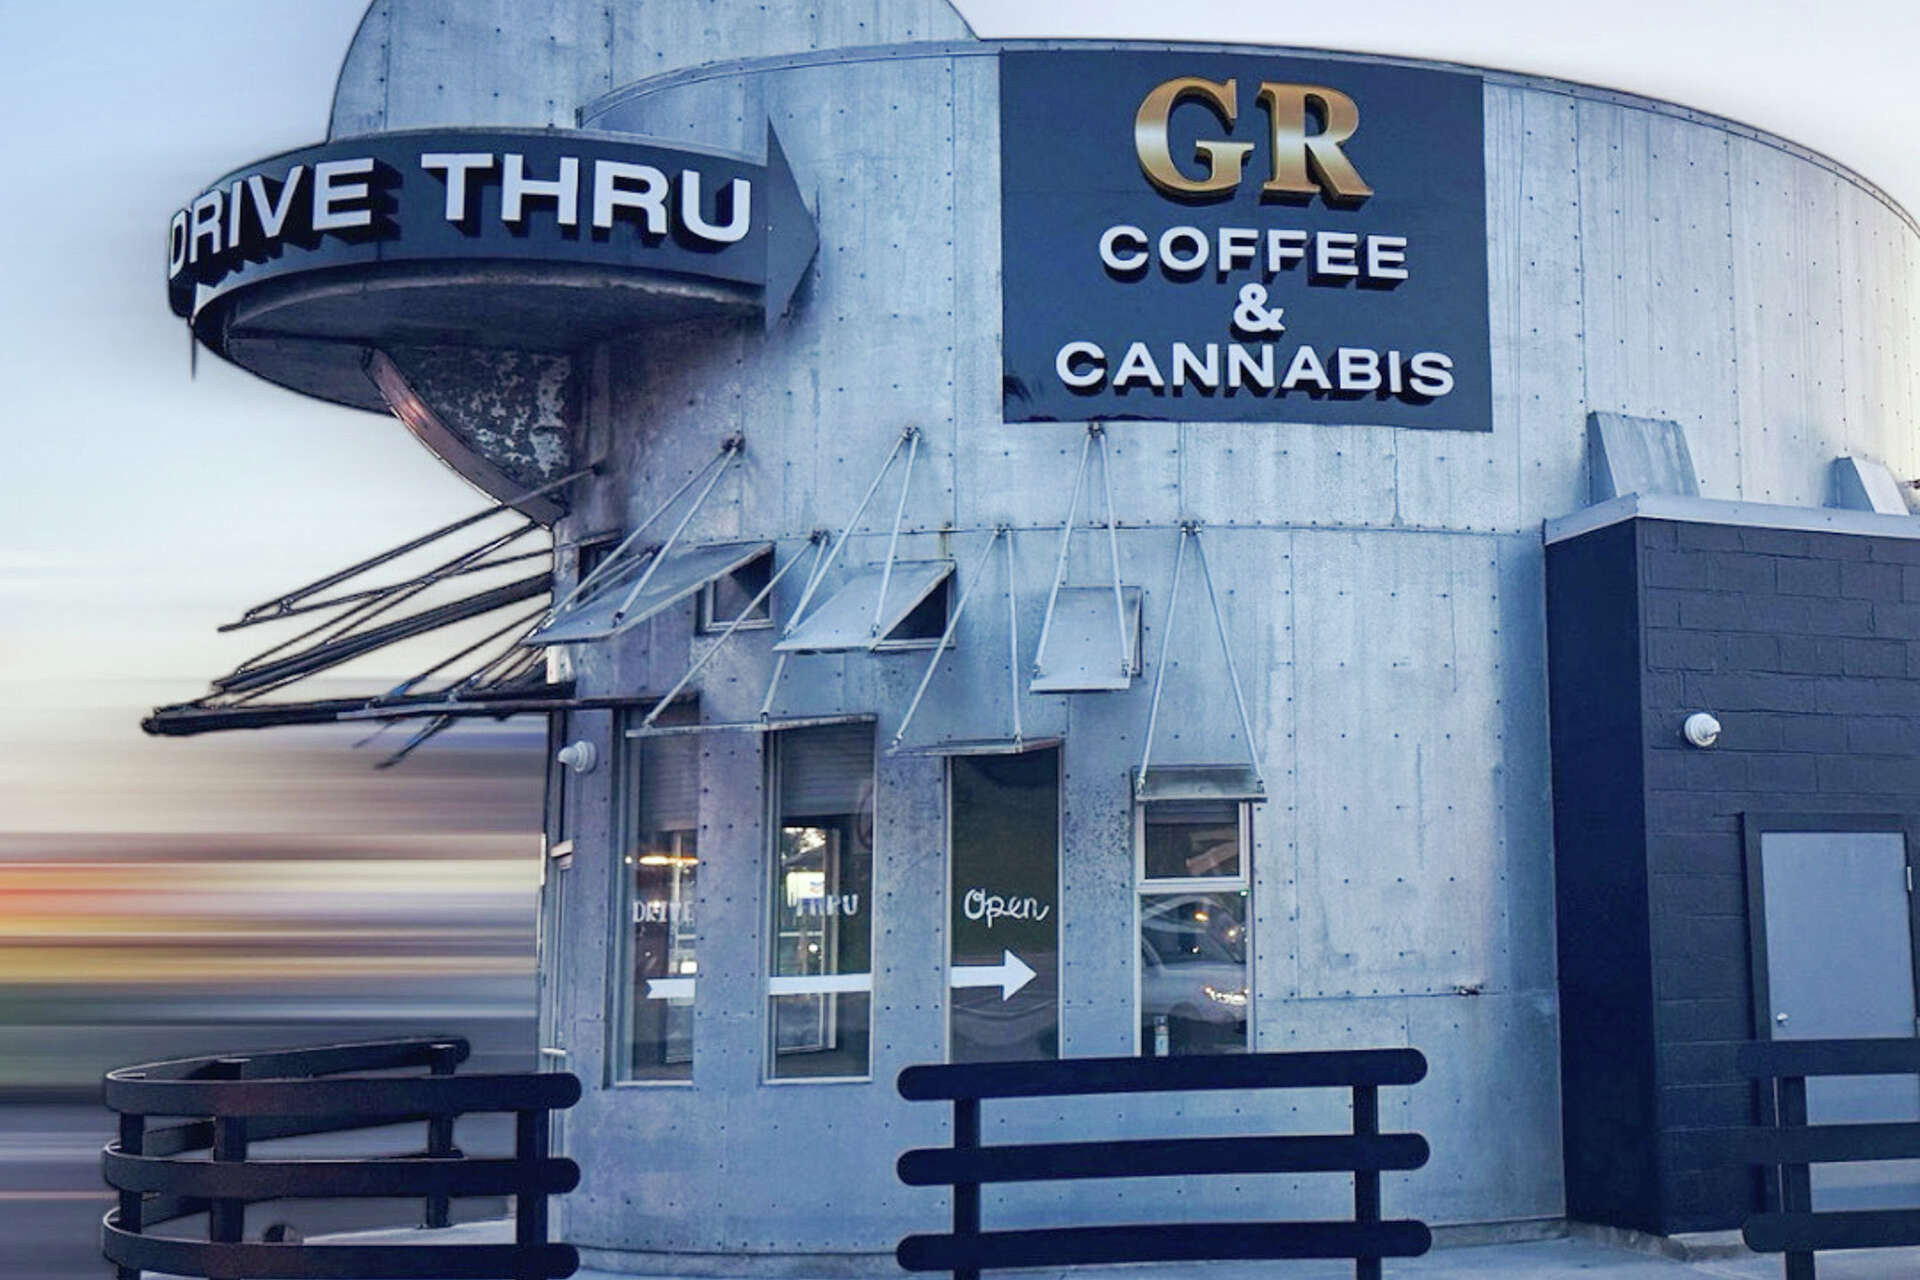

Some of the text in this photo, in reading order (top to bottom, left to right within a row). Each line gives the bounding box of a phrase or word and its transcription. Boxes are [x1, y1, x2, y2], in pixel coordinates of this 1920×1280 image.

[1134, 77, 1374, 198] GR
[169, 152, 751, 280] DRIVE THRU
[1099, 225, 1409, 279] COFFEE
[1233, 282, 1285, 332] &
[1055, 341, 1455, 396] CANNABIS
[632, 900, 695, 926] DRIVE
[964, 888, 1050, 928] Open
